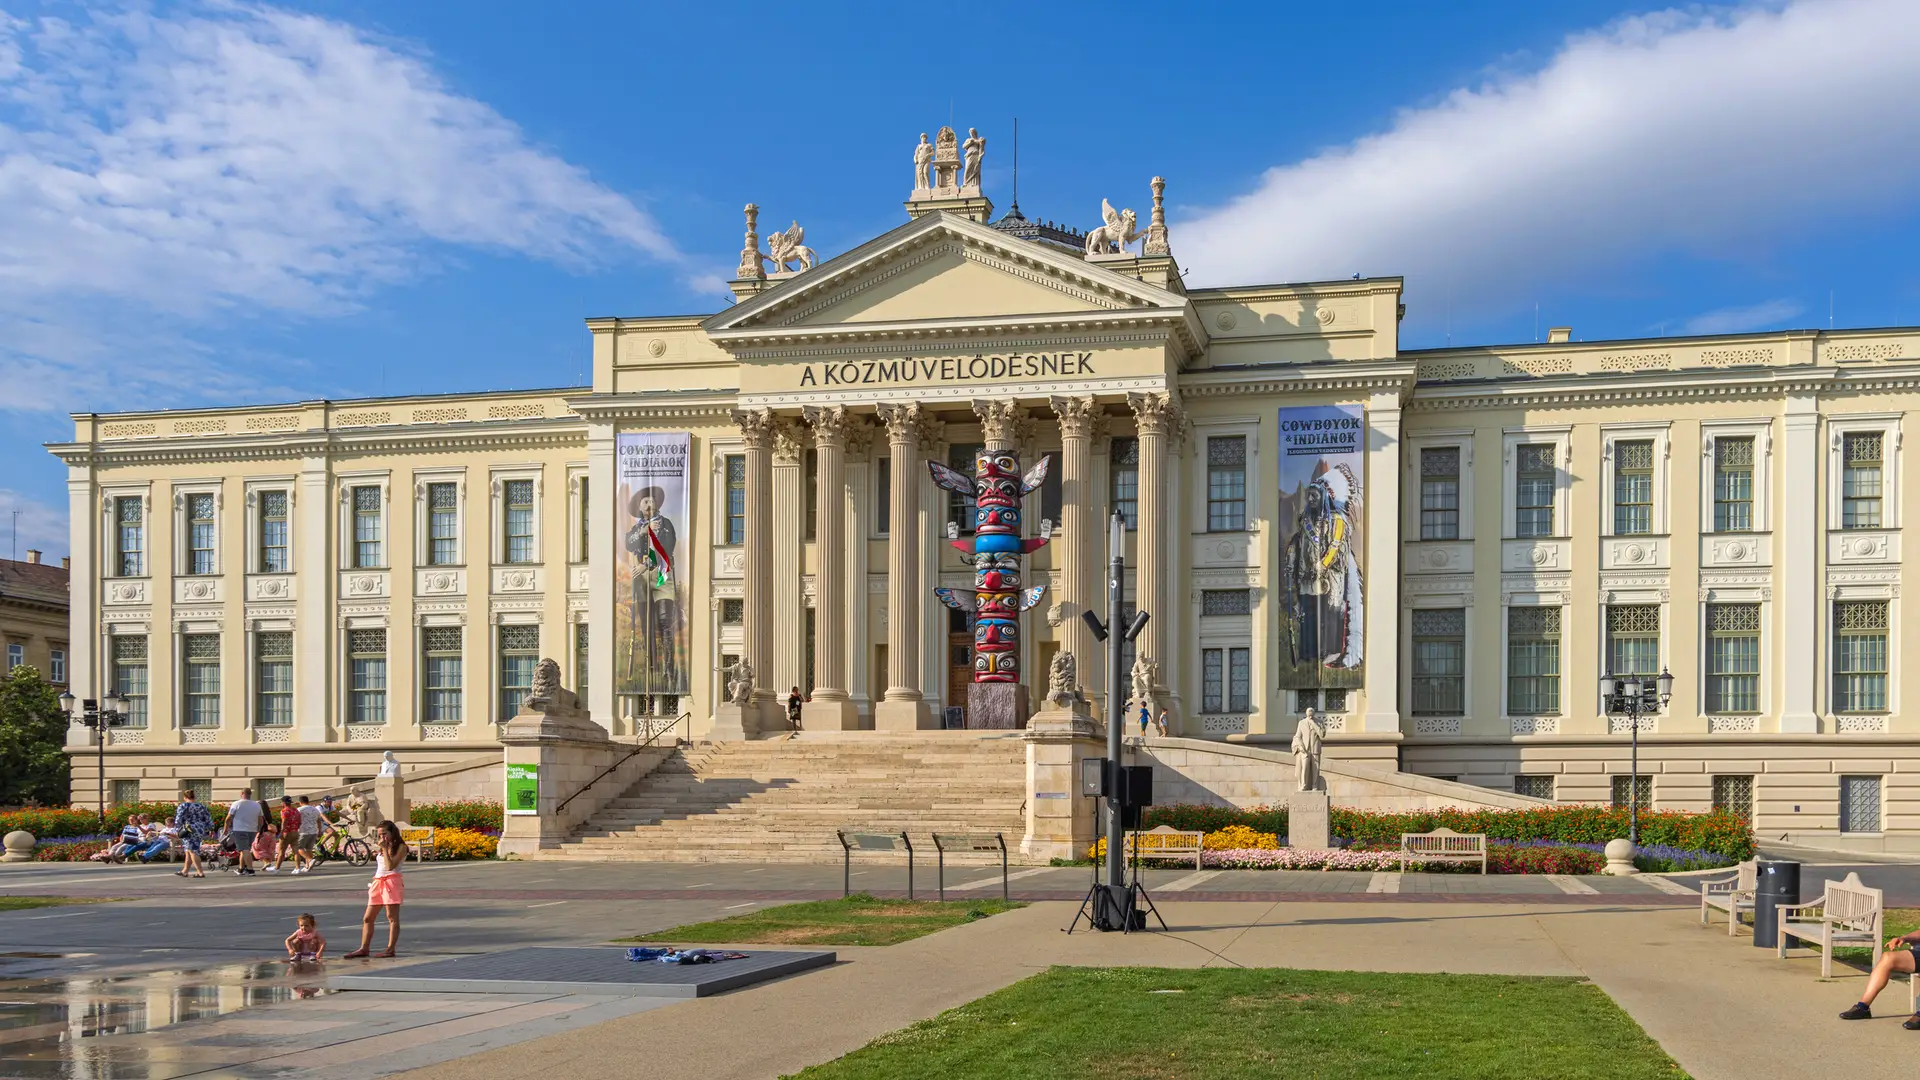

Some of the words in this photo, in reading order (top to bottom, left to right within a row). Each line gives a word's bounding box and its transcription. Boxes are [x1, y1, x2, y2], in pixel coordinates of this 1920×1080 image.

[800, 366, 817, 386] A
[1281, 418, 1360, 432] COWBOYOK
[1293, 431, 1356, 445] INDIÁNOK
[619, 444, 687, 455] COWBOYOK
[629, 455, 685, 468] INDIÁNOK
